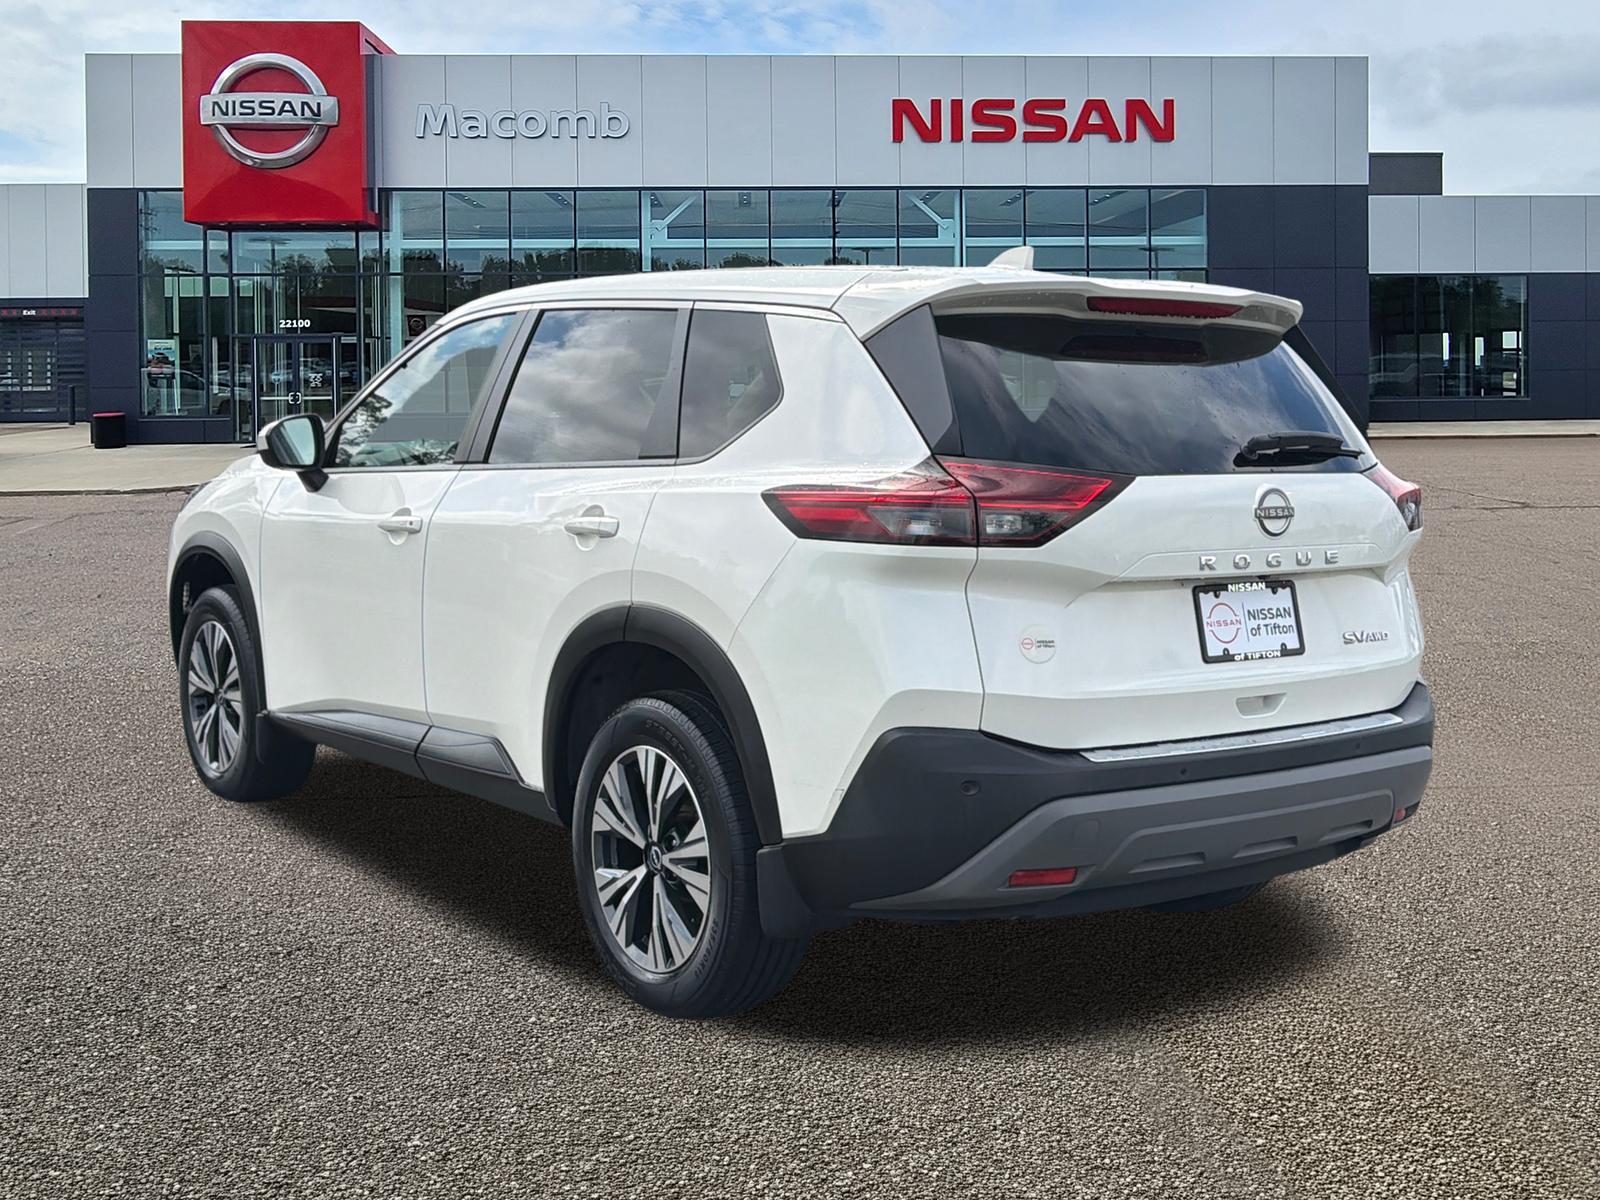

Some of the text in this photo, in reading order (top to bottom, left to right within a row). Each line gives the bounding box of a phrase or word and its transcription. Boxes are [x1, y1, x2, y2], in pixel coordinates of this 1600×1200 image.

[212, 100, 322, 117] NISSAN
[415, 101, 630, 138] Macomb
[892, 98, 1175, 142] NISSAN
[279, 319, 311, 328] 22100
[1256, 508, 1294, 517] NISSAN
[1199, 550, 1339, 571] ROGUE
[1227, 582, 1266, 592] NISSAN
[1247, 607, 1292, 621] NISSAN
[1206, 618, 1242, 628] NISSAN
[1250, 622, 1295, 637] of Tifton
[1247, 650, 1281, 660] TIFTON
